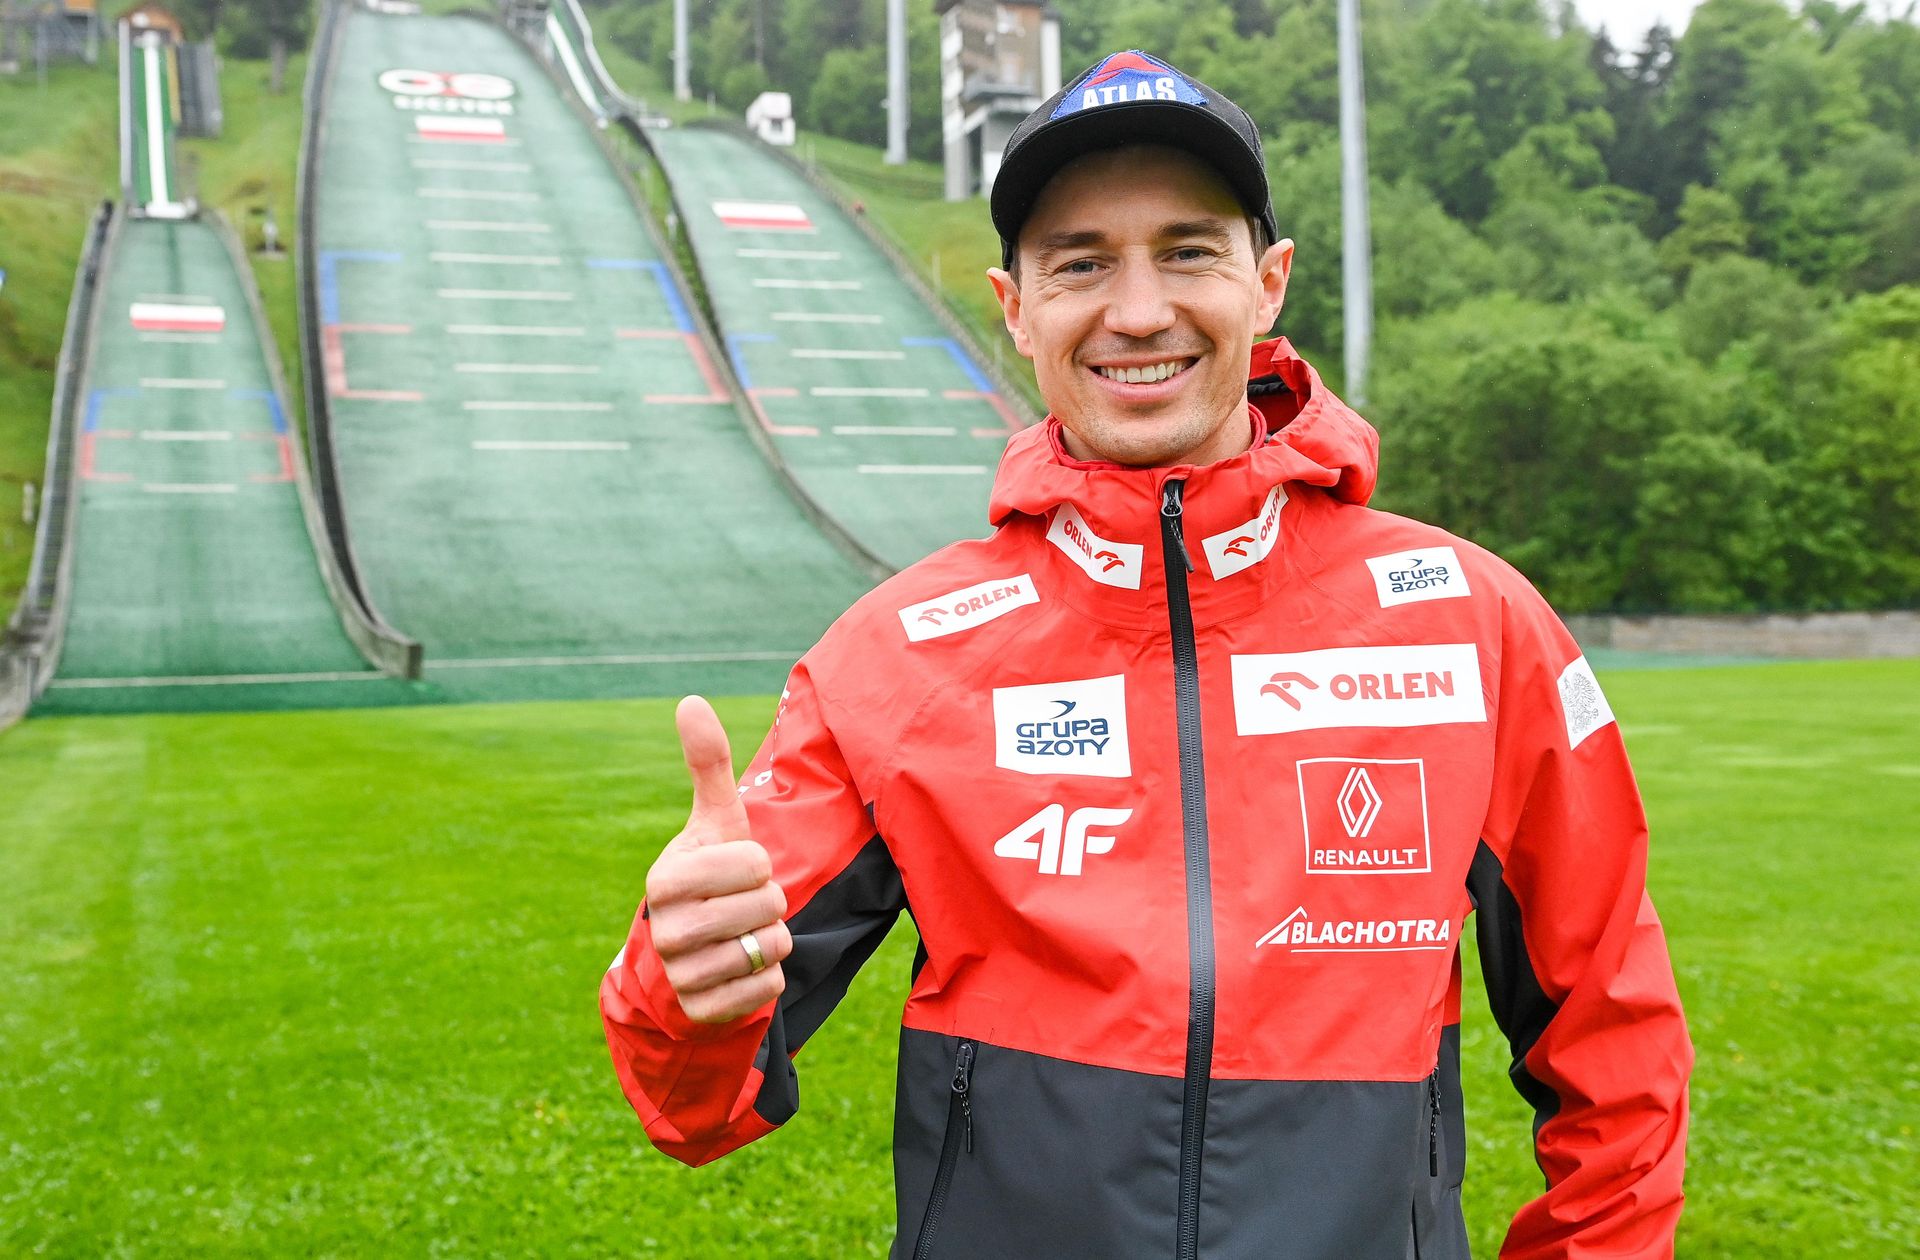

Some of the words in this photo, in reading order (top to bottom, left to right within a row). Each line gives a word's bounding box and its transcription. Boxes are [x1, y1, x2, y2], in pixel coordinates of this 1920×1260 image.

[1082, 77, 1177, 109] ATLAS
[1260, 485, 1280, 541] ORLEN
[1063, 519, 1093, 560] ORLEN
[954, 584, 1021, 617] ORLEN
[1329, 670, 1455, 701] ORLEN
[993, 803, 1134, 876] 4F
[1313, 848, 1418, 865] RENAULT
